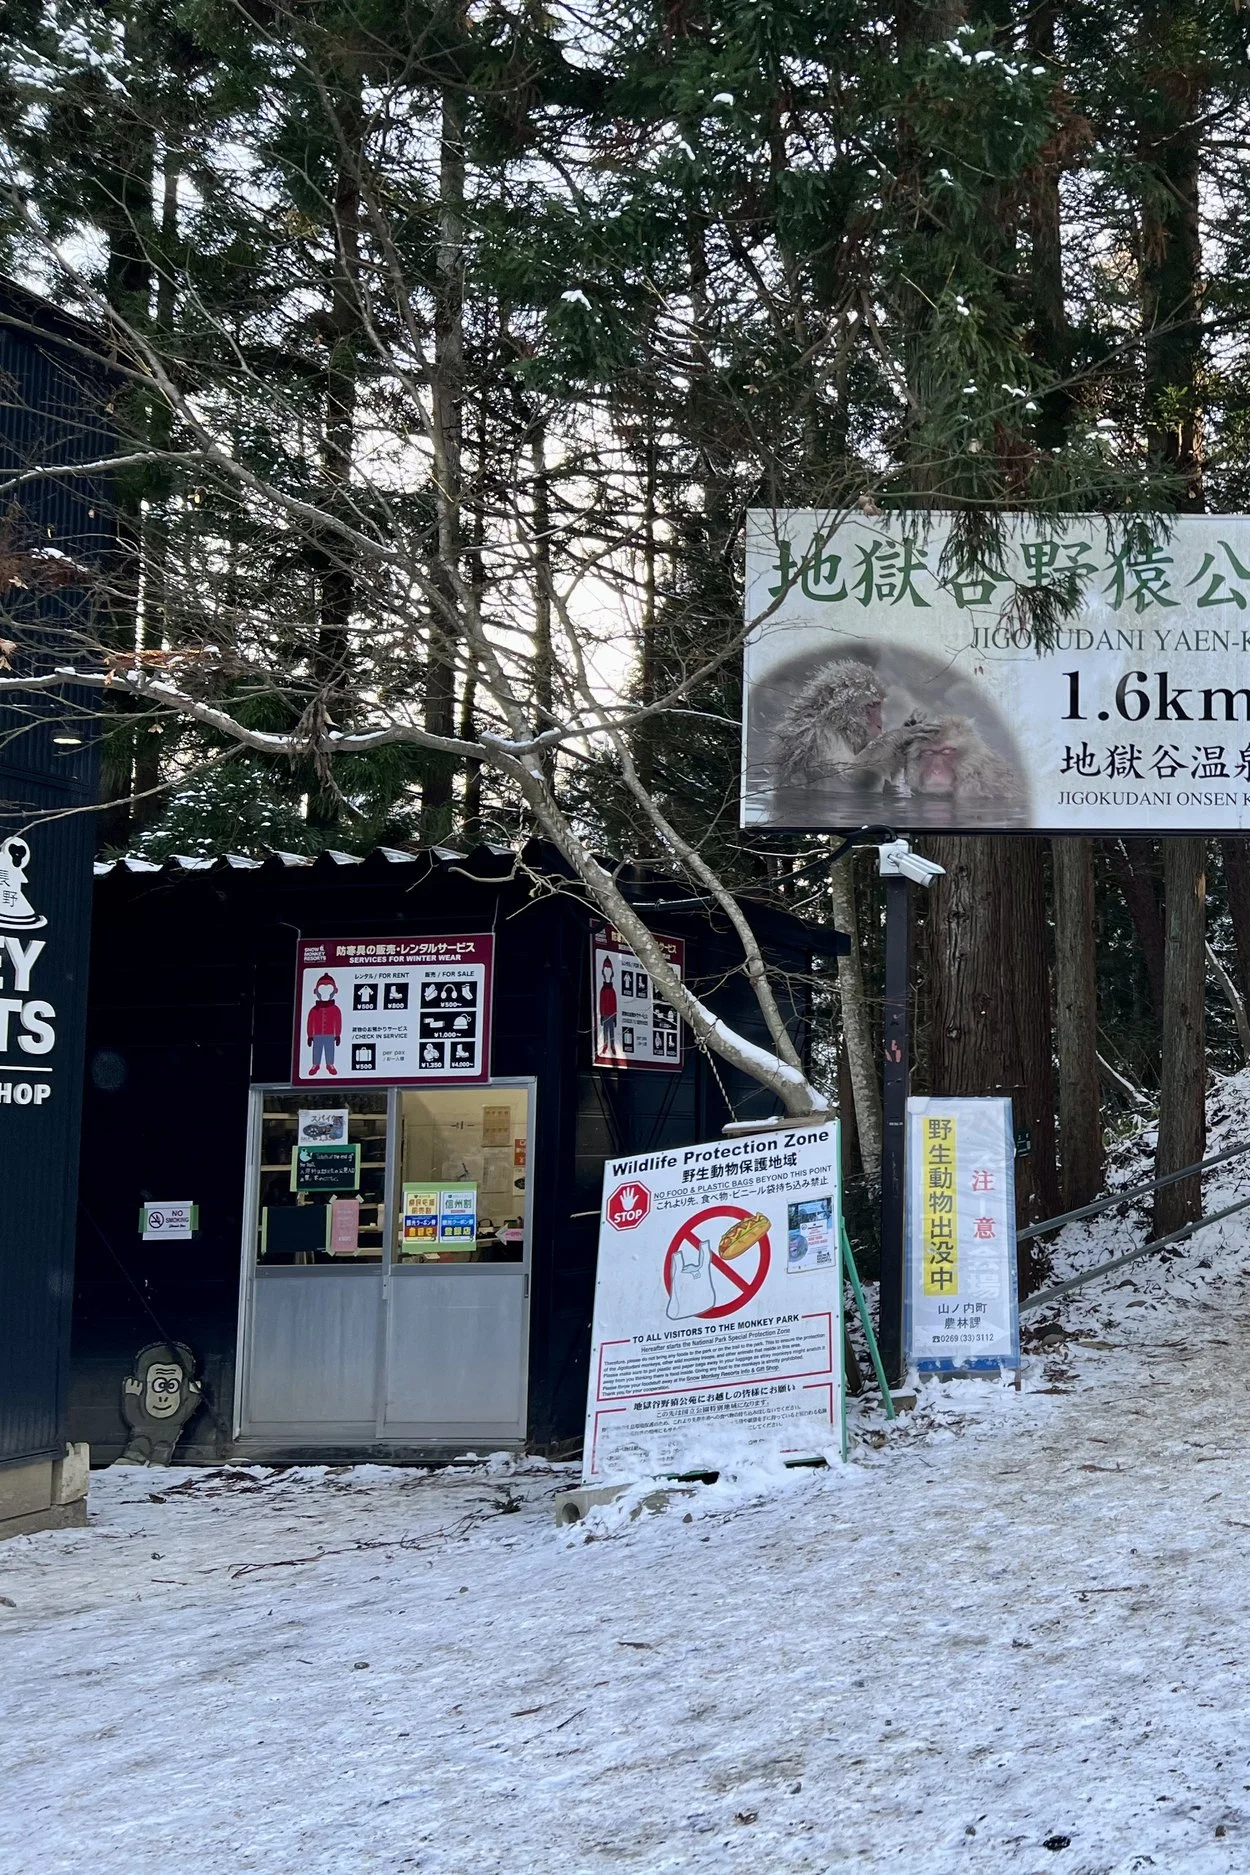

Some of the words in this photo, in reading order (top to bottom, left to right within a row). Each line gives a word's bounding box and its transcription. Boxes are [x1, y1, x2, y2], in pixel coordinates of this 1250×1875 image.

[971, 628, 1144, 651] JIGOUDANI
[1058, 791, 1172, 807] JIGOKUDANI
[1176, 792, 1238, 807] ONSEN
[336, 942, 475, 957] 防寒具の販売・レンタルサービス
[349, 956, 387, 964] SERVICES
[612, 1155, 677, 1177] Wildlife
[683, 1140, 778, 1165] Protection
[784, 1131, 829, 1148] Zone
[682, 1152, 797, 1184] 野生動物保護地域
[653, 1191, 666, 1199] NO
[667, 1188, 688, 1197] FOOD
[690, 1186, 696, 1194] &
[698, 1181, 730, 1193] PLASTIC
[731, 1178, 754, 1187] BAGS
[756, 1172, 789, 1184] BEYOND
[790, 1169, 808, 1178] THIS
[809, 1164, 832, 1175] POINT
[614, 1209, 643, 1223] STOP
[928, 1118, 954, 1292] 野生動物出没中
[971, 1169, 997, 1240] 注意
[938, 1302, 988, 1315] 山ノ内町
[633, 1335, 644, 1344] TO
[646, 1334, 662, 1342] ALL
[664, 1327, 703, 1339] VISITORS
[704, 1325, 716, 1334] TO
[719, 1323, 735, 1332] THE
[737, 1317, 774, 1329] MONKEY
[776, 1314, 800, 1323] PARK
[944, 1316, 982, 1330] 農林課
[641, 1344, 666, 1353] Hereafter
[692, 1338, 714, 1347] National
[728, 1333, 747, 1342] Special
[749, 1329, 776, 1339] Protection
